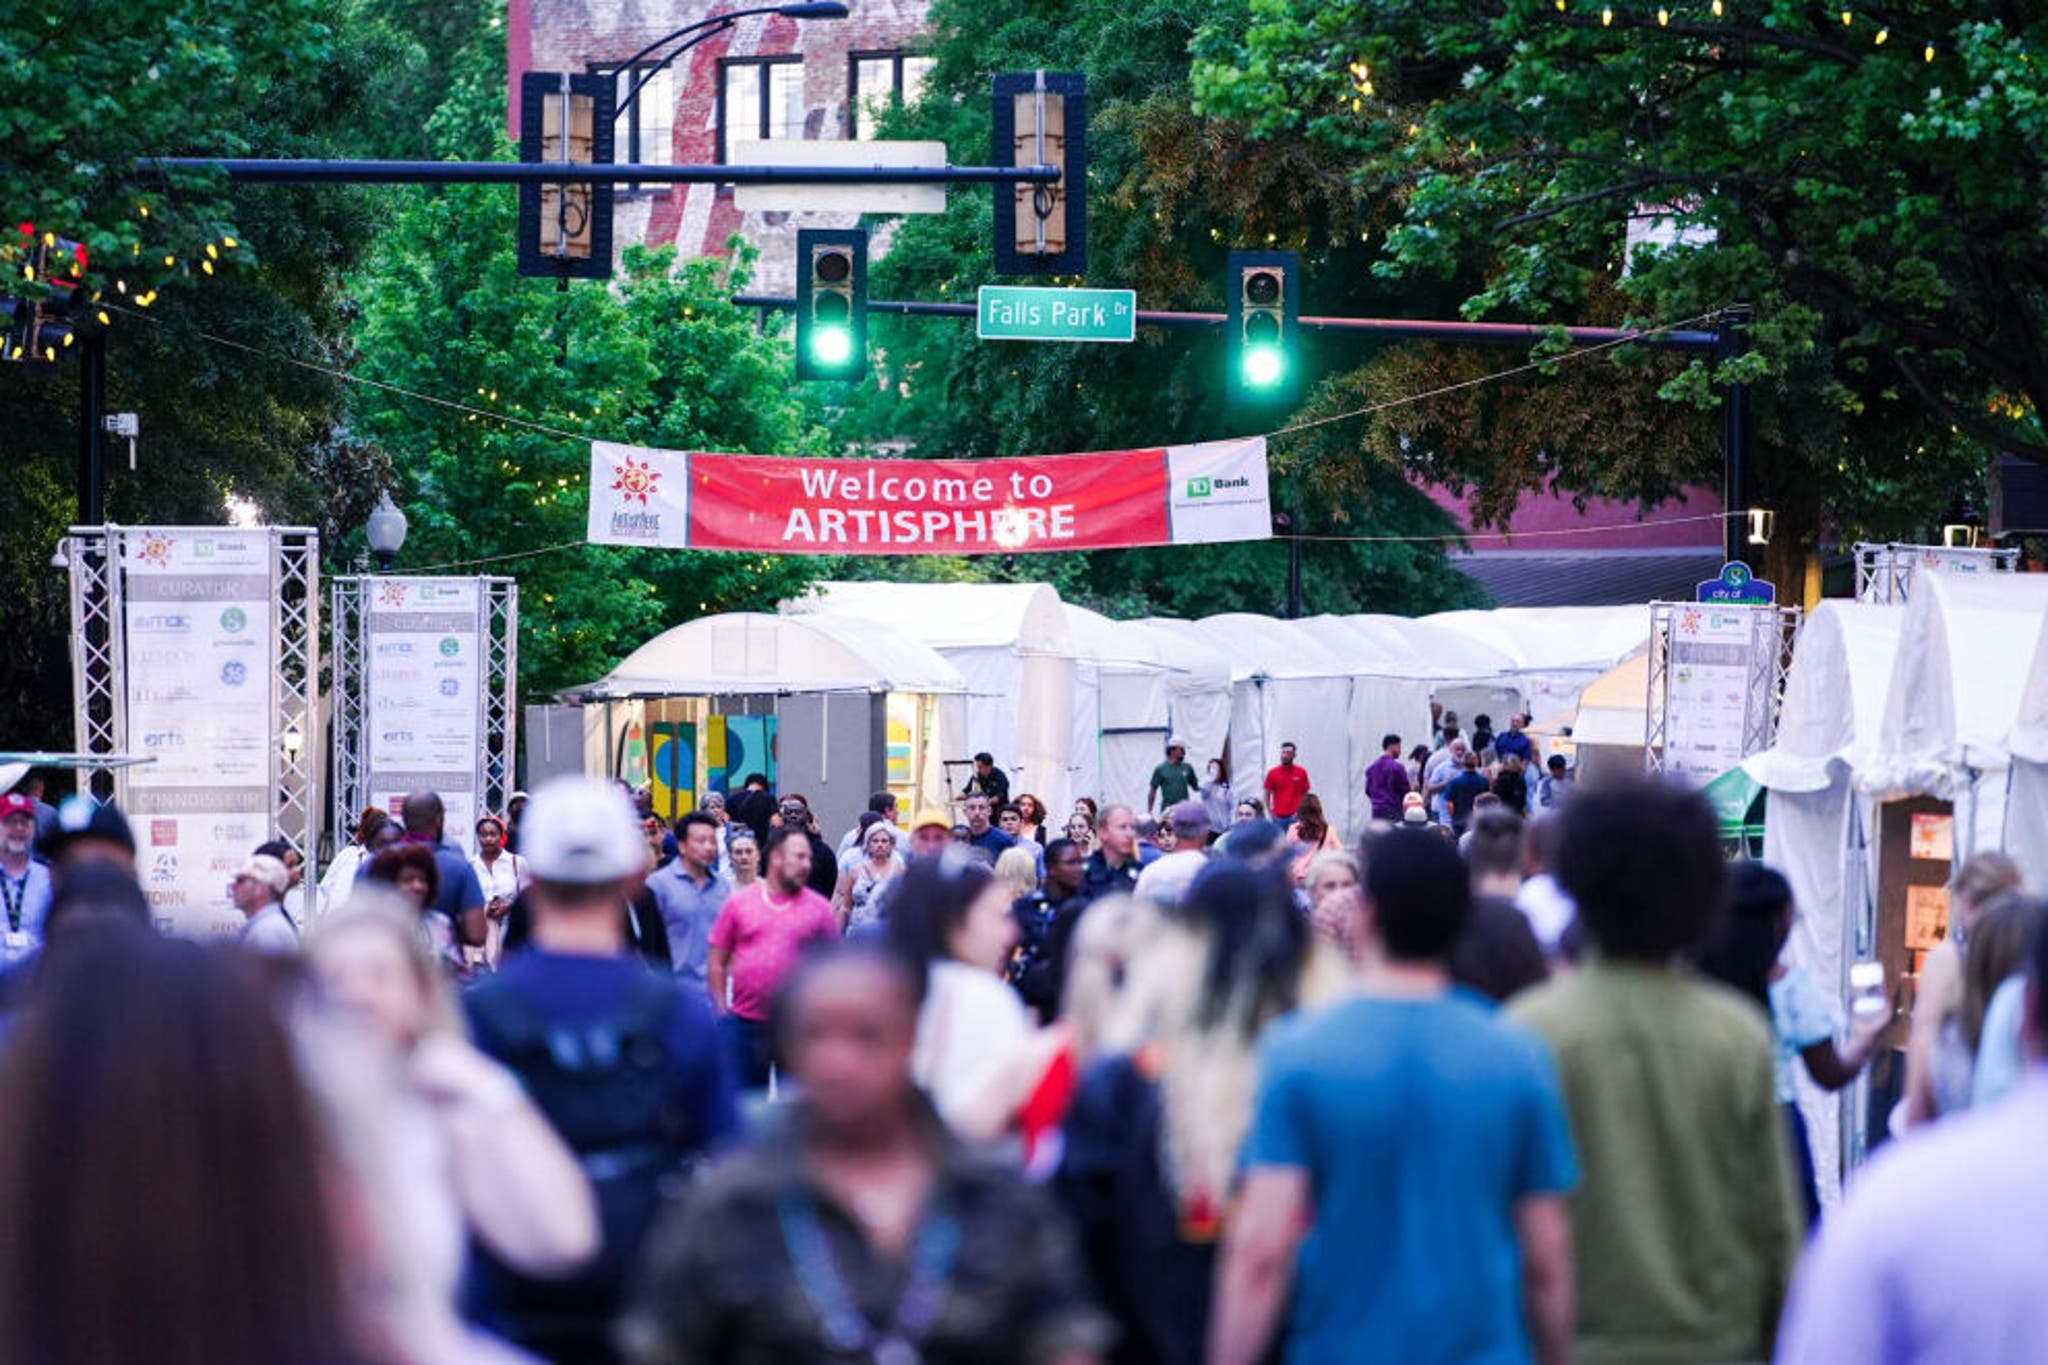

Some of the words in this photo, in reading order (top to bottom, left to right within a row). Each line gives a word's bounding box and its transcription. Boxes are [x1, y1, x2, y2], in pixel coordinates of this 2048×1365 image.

[989, 299, 1041, 326] Falls
[1052, 301, 1106, 327] Park
[1114, 301, 1128, 315] Dr
[801, 468, 993, 501] Welcome
[1009, 471, 1052, 499] to
[1214, 475, 1249, 488] Bank
[1712, 588, 1729, 599] city
[1731, 588, 1742, 599] of
